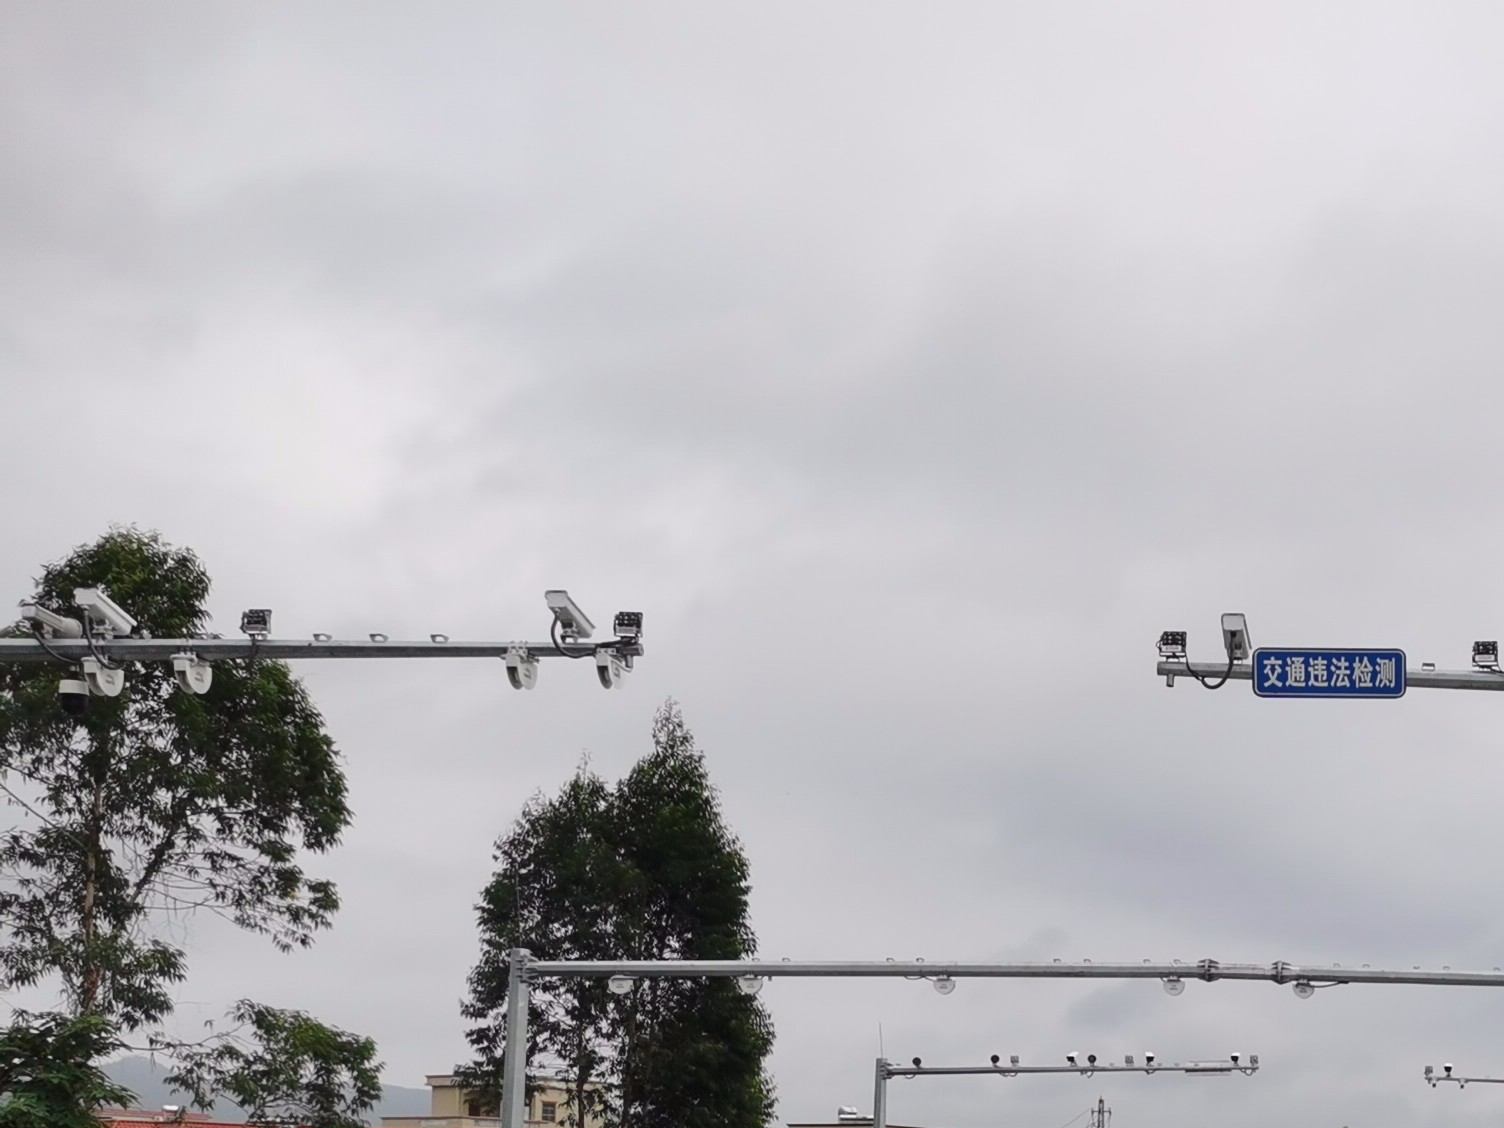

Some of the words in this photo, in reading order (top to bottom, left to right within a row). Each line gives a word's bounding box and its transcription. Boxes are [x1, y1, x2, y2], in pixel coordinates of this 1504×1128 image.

[1263, 656, 1396, 689] 交通违法检测
